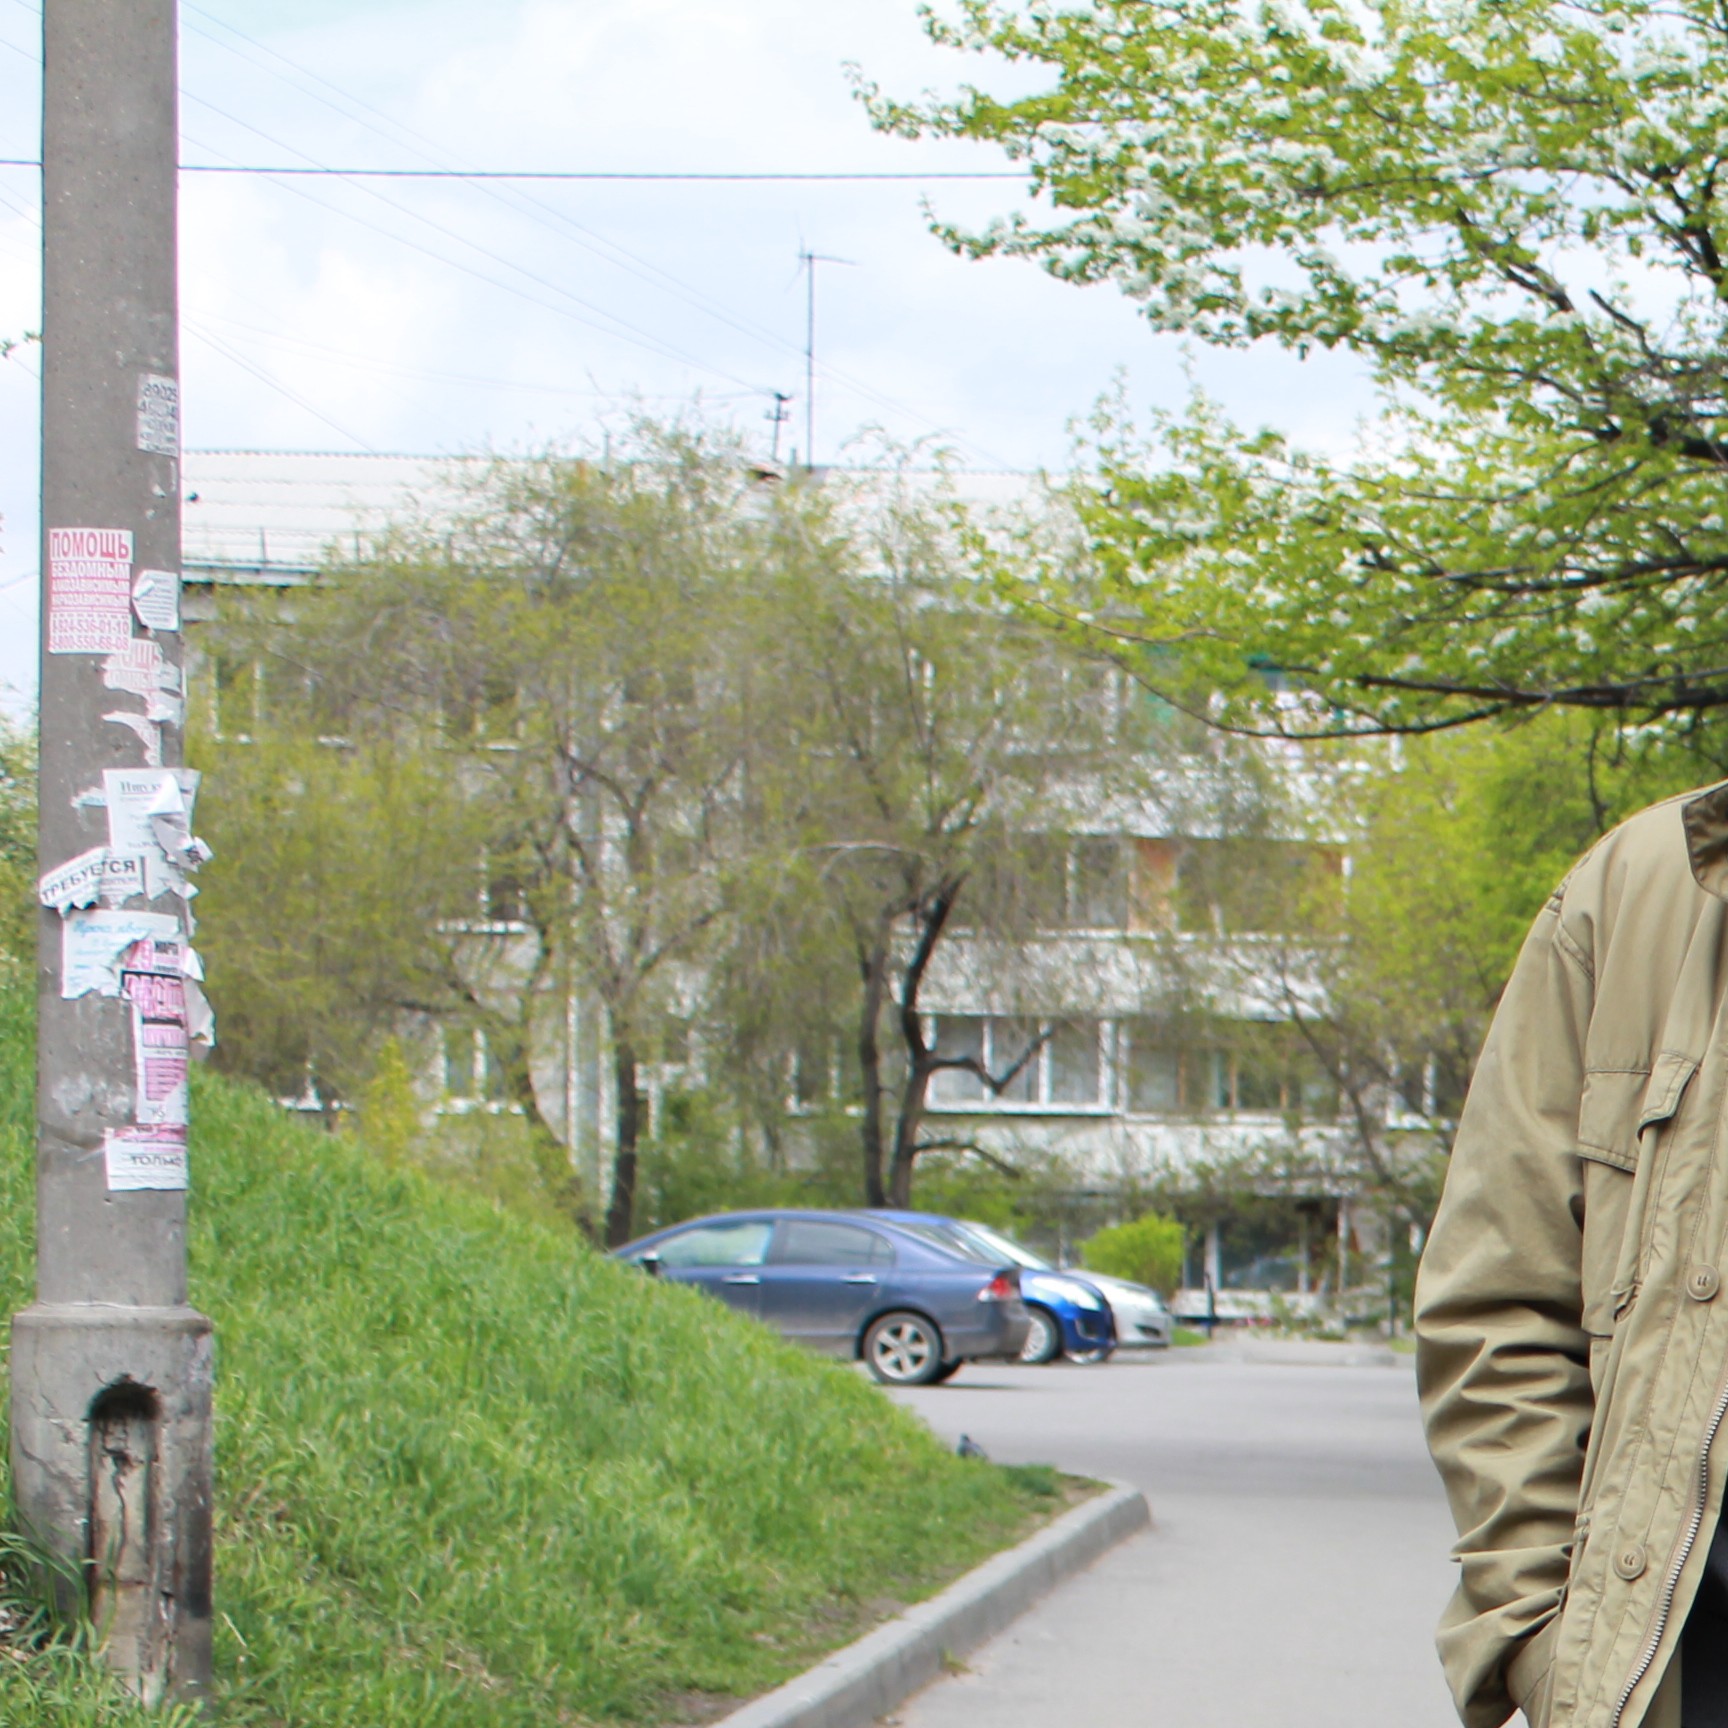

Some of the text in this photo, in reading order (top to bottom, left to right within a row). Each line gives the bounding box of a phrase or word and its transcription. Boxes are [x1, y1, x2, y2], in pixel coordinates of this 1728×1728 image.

[51, 531, 129, 560] ПОМОЩЬ
[52, 562, 130, 579] БЕЗДОМНЫМ
[42, 860, 136, 900] ТРЕБУЕТСЯ
